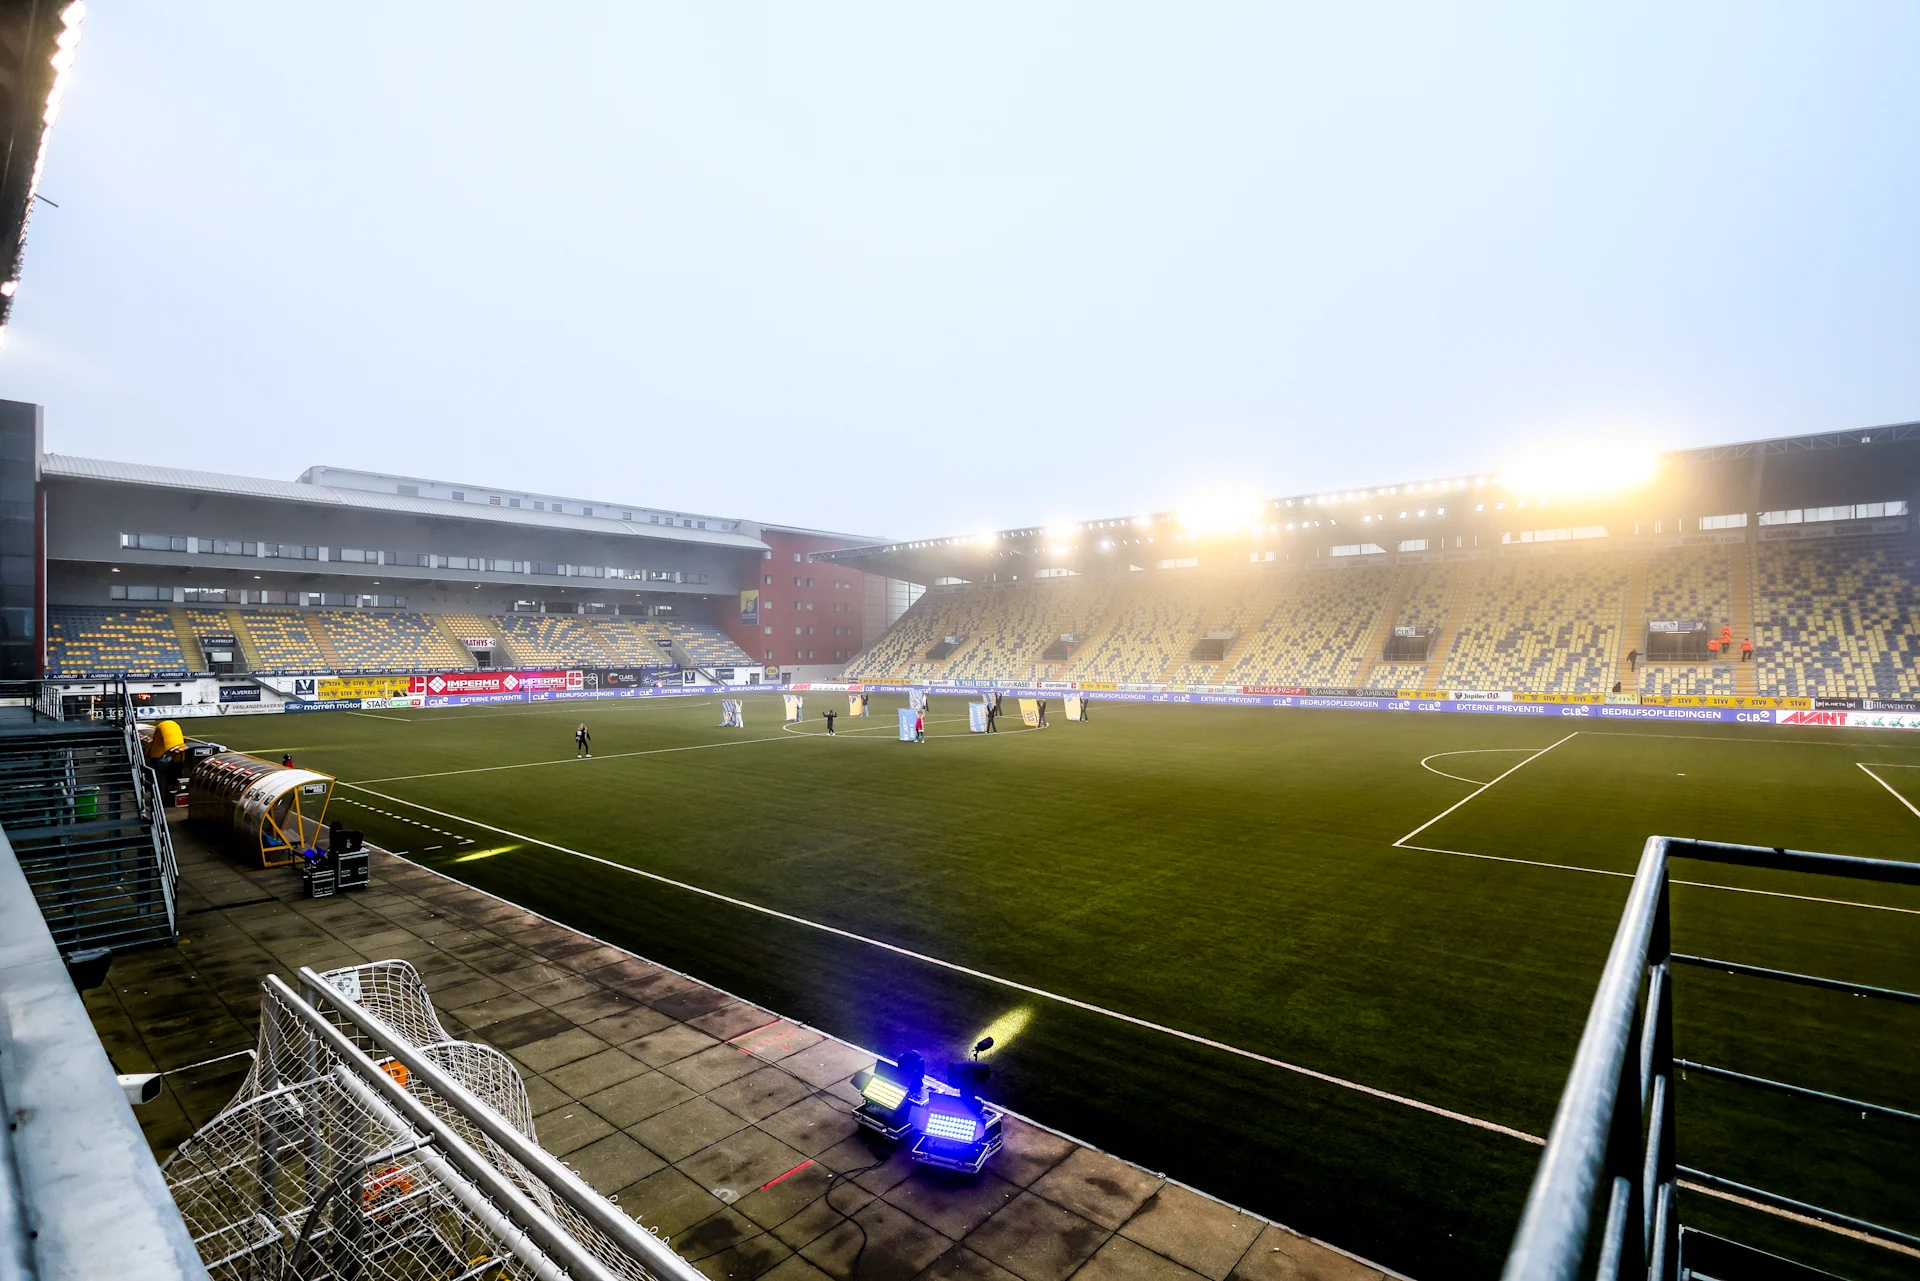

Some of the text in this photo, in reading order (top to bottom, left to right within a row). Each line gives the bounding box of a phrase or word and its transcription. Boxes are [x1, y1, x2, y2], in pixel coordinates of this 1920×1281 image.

[447, 680, 500, 688] IMPERMO
[519, 678, 566, 686] IMPERMO
[556, 690, 614, 698] BEDRIJFSOPLEIDINGEN
[1364, 690, 1396, 698] AMBIORIX
[1300, 700, 1378, 708] BEDRIJFSOPLEIDINGEN
[1863, 700, 1916, 710] Hillewaere
[1418, 703, 1580, 716] CLB EXTERNE PREVENTIE CLB
[1602, 708, 1760, 722] BEDRIJFSOPLEIDINGEN CLB
[1780, 712, 1848, 726] AVANT
